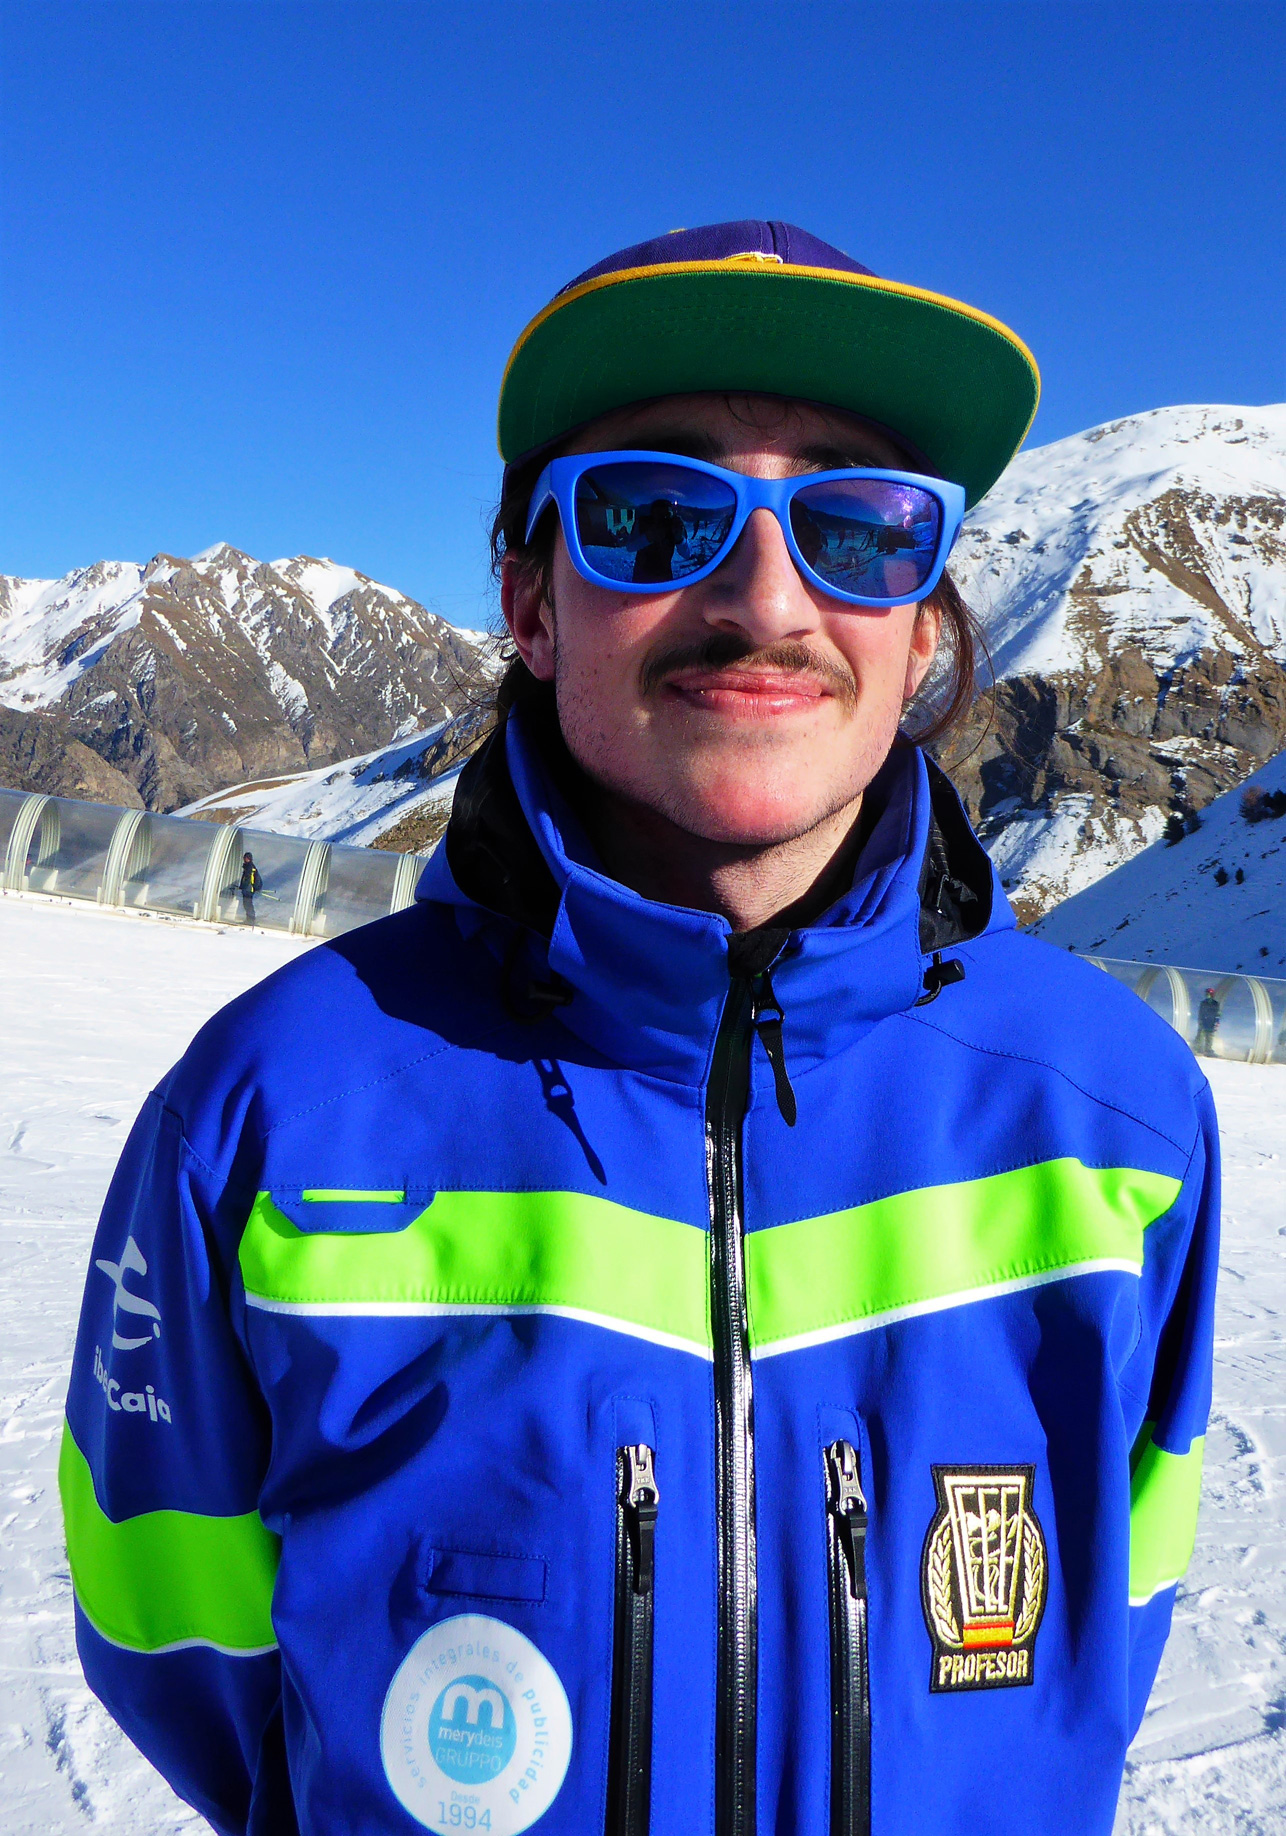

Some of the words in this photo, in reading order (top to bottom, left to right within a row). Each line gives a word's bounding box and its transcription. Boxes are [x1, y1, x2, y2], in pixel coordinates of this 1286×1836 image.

[419, 1640, 500, 1687] integrales
[506, 1660, 525, 1684] de
[938, 1649, 1029, 1686] PROFESOR
[400, 1692, 427, 1790] servicios
[437, 1726, 503, 1749] merydeis
[508, 1688, 550, 1805] publicidad
[435, 1746, 502, 1772] GRUPPO
[450, 1791, 481, 1805] Desde
[438, 1801, 492, 1832] 1994
